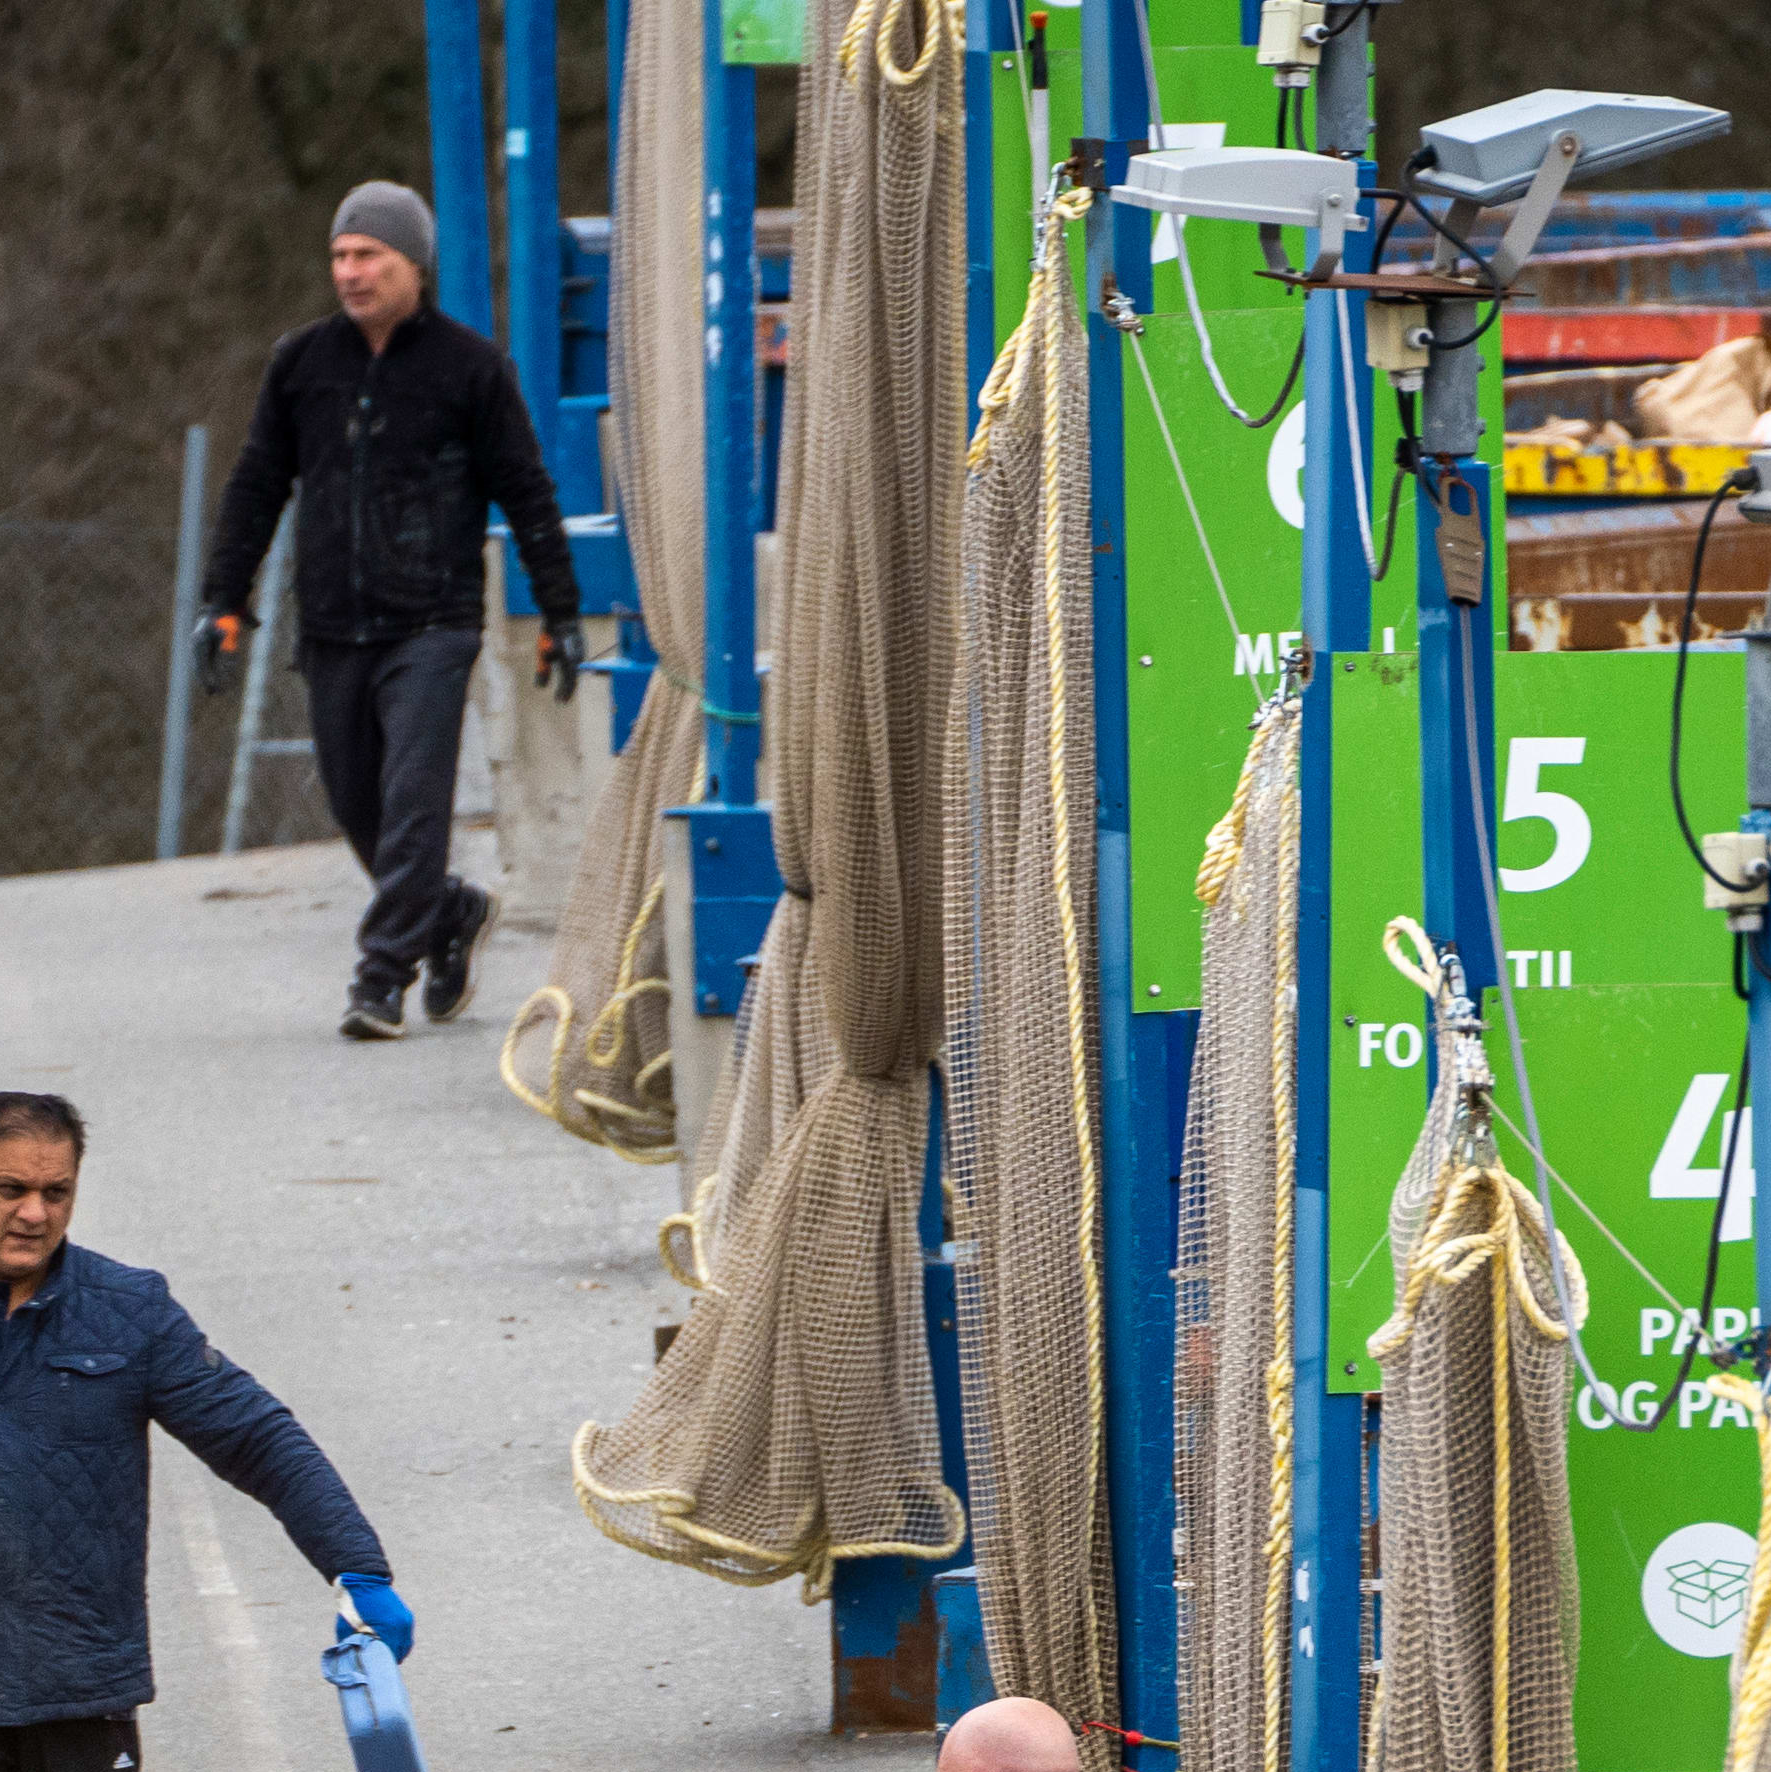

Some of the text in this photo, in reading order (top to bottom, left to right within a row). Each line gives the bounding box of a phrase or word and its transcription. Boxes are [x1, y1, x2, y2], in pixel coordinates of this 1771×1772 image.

[1499, 736, 1592, 893] 5
[1649, 1073, 1756, 1242] 4
[1640, 1307, 1761, 1356] PAP
[1577, 1380, 1764, 1430] OG PA
